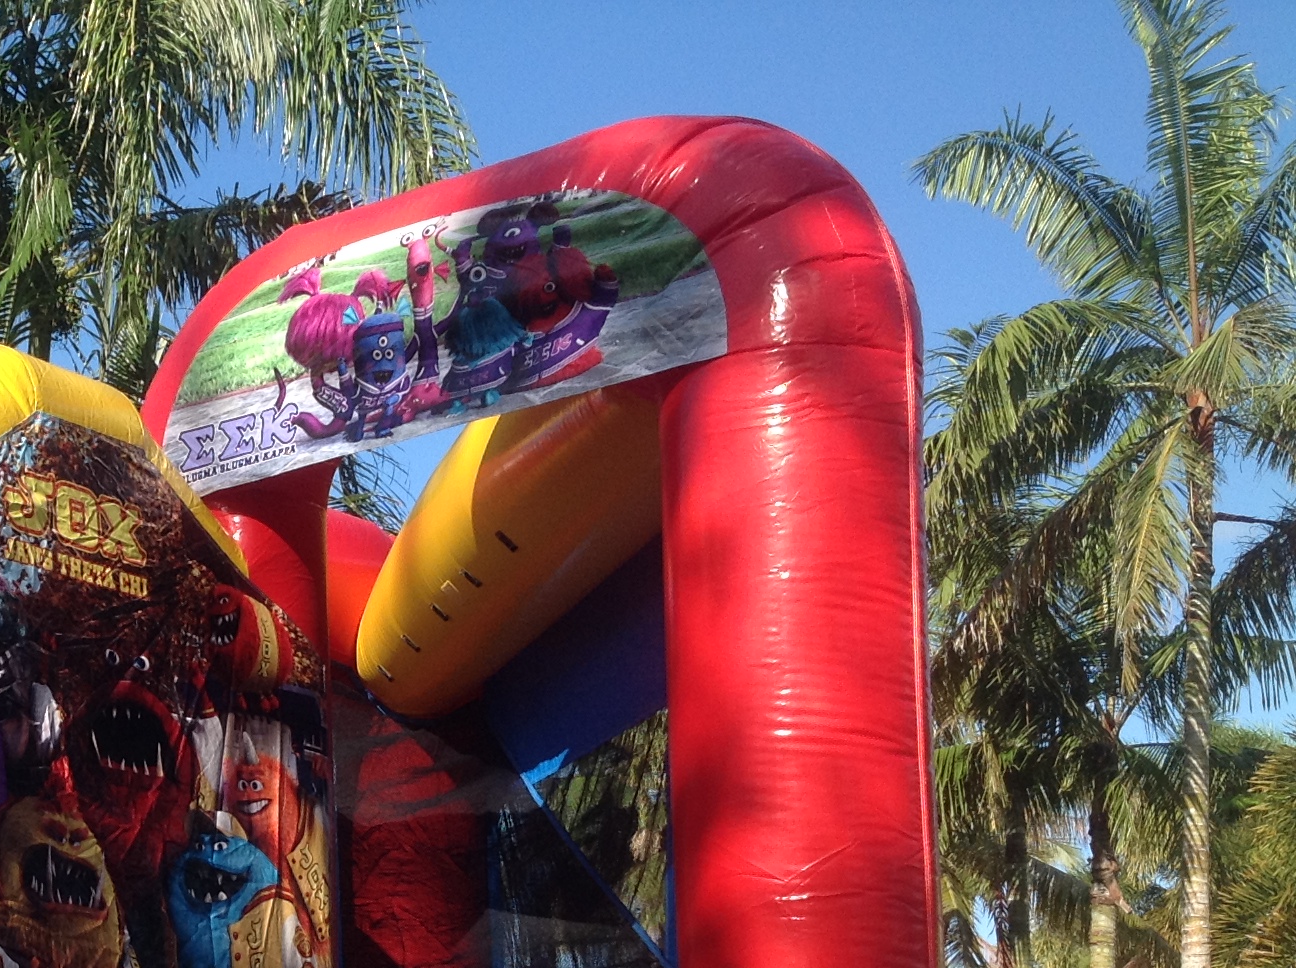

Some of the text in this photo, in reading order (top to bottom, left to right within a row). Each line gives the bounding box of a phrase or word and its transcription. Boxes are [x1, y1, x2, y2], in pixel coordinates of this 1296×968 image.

[261, 443, 296, 462] KAPPA
[56, 552, 116, 590] THETA
[117, 571, 149, 598] CHI
